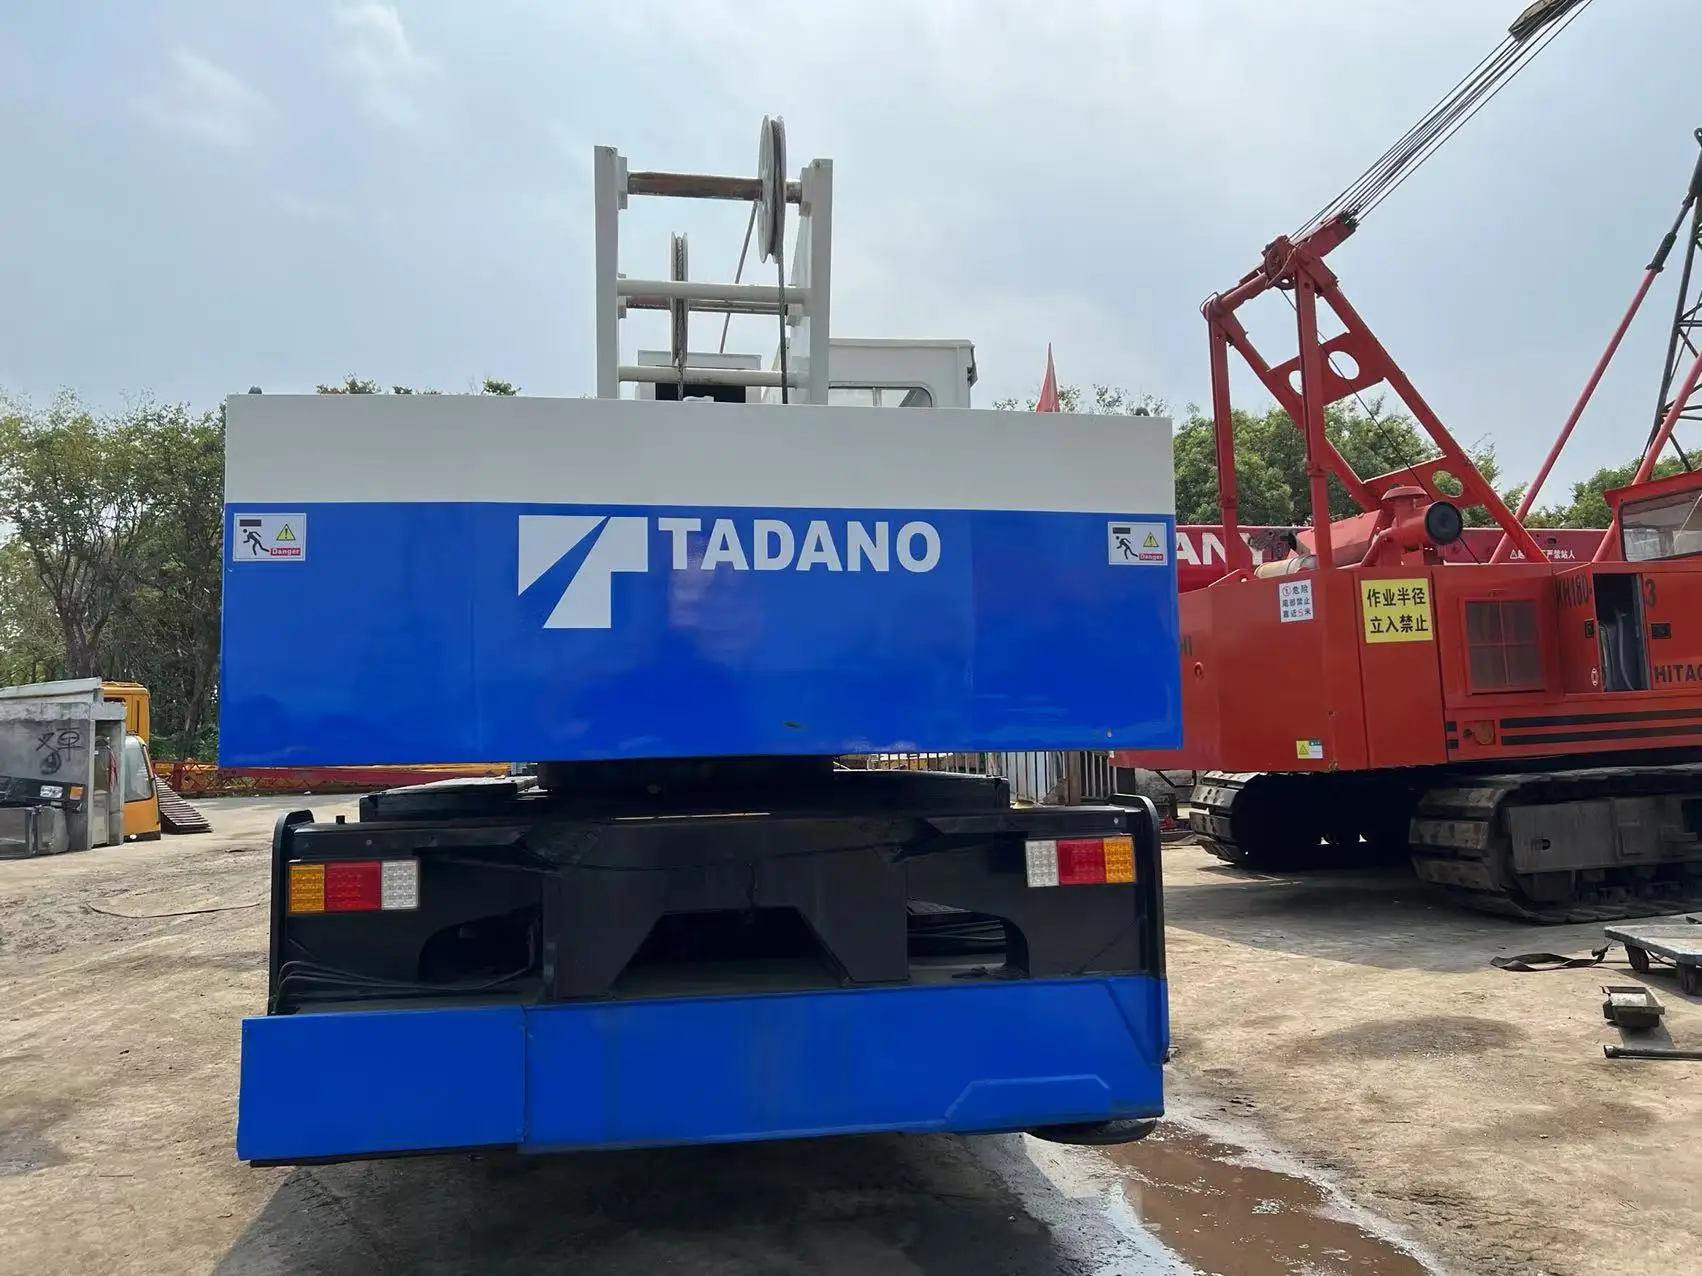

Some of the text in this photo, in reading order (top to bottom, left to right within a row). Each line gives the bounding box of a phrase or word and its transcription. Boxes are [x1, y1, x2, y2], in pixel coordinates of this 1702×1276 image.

[271, 548, 300, 556] Danger
[658, 517, 941, 573] TADANO
[1140, 553, 1163, 561] Danger
[1367, 587, 1426, 608] 作业半径
[1370, 614, 1429, 633] 立入禁止
